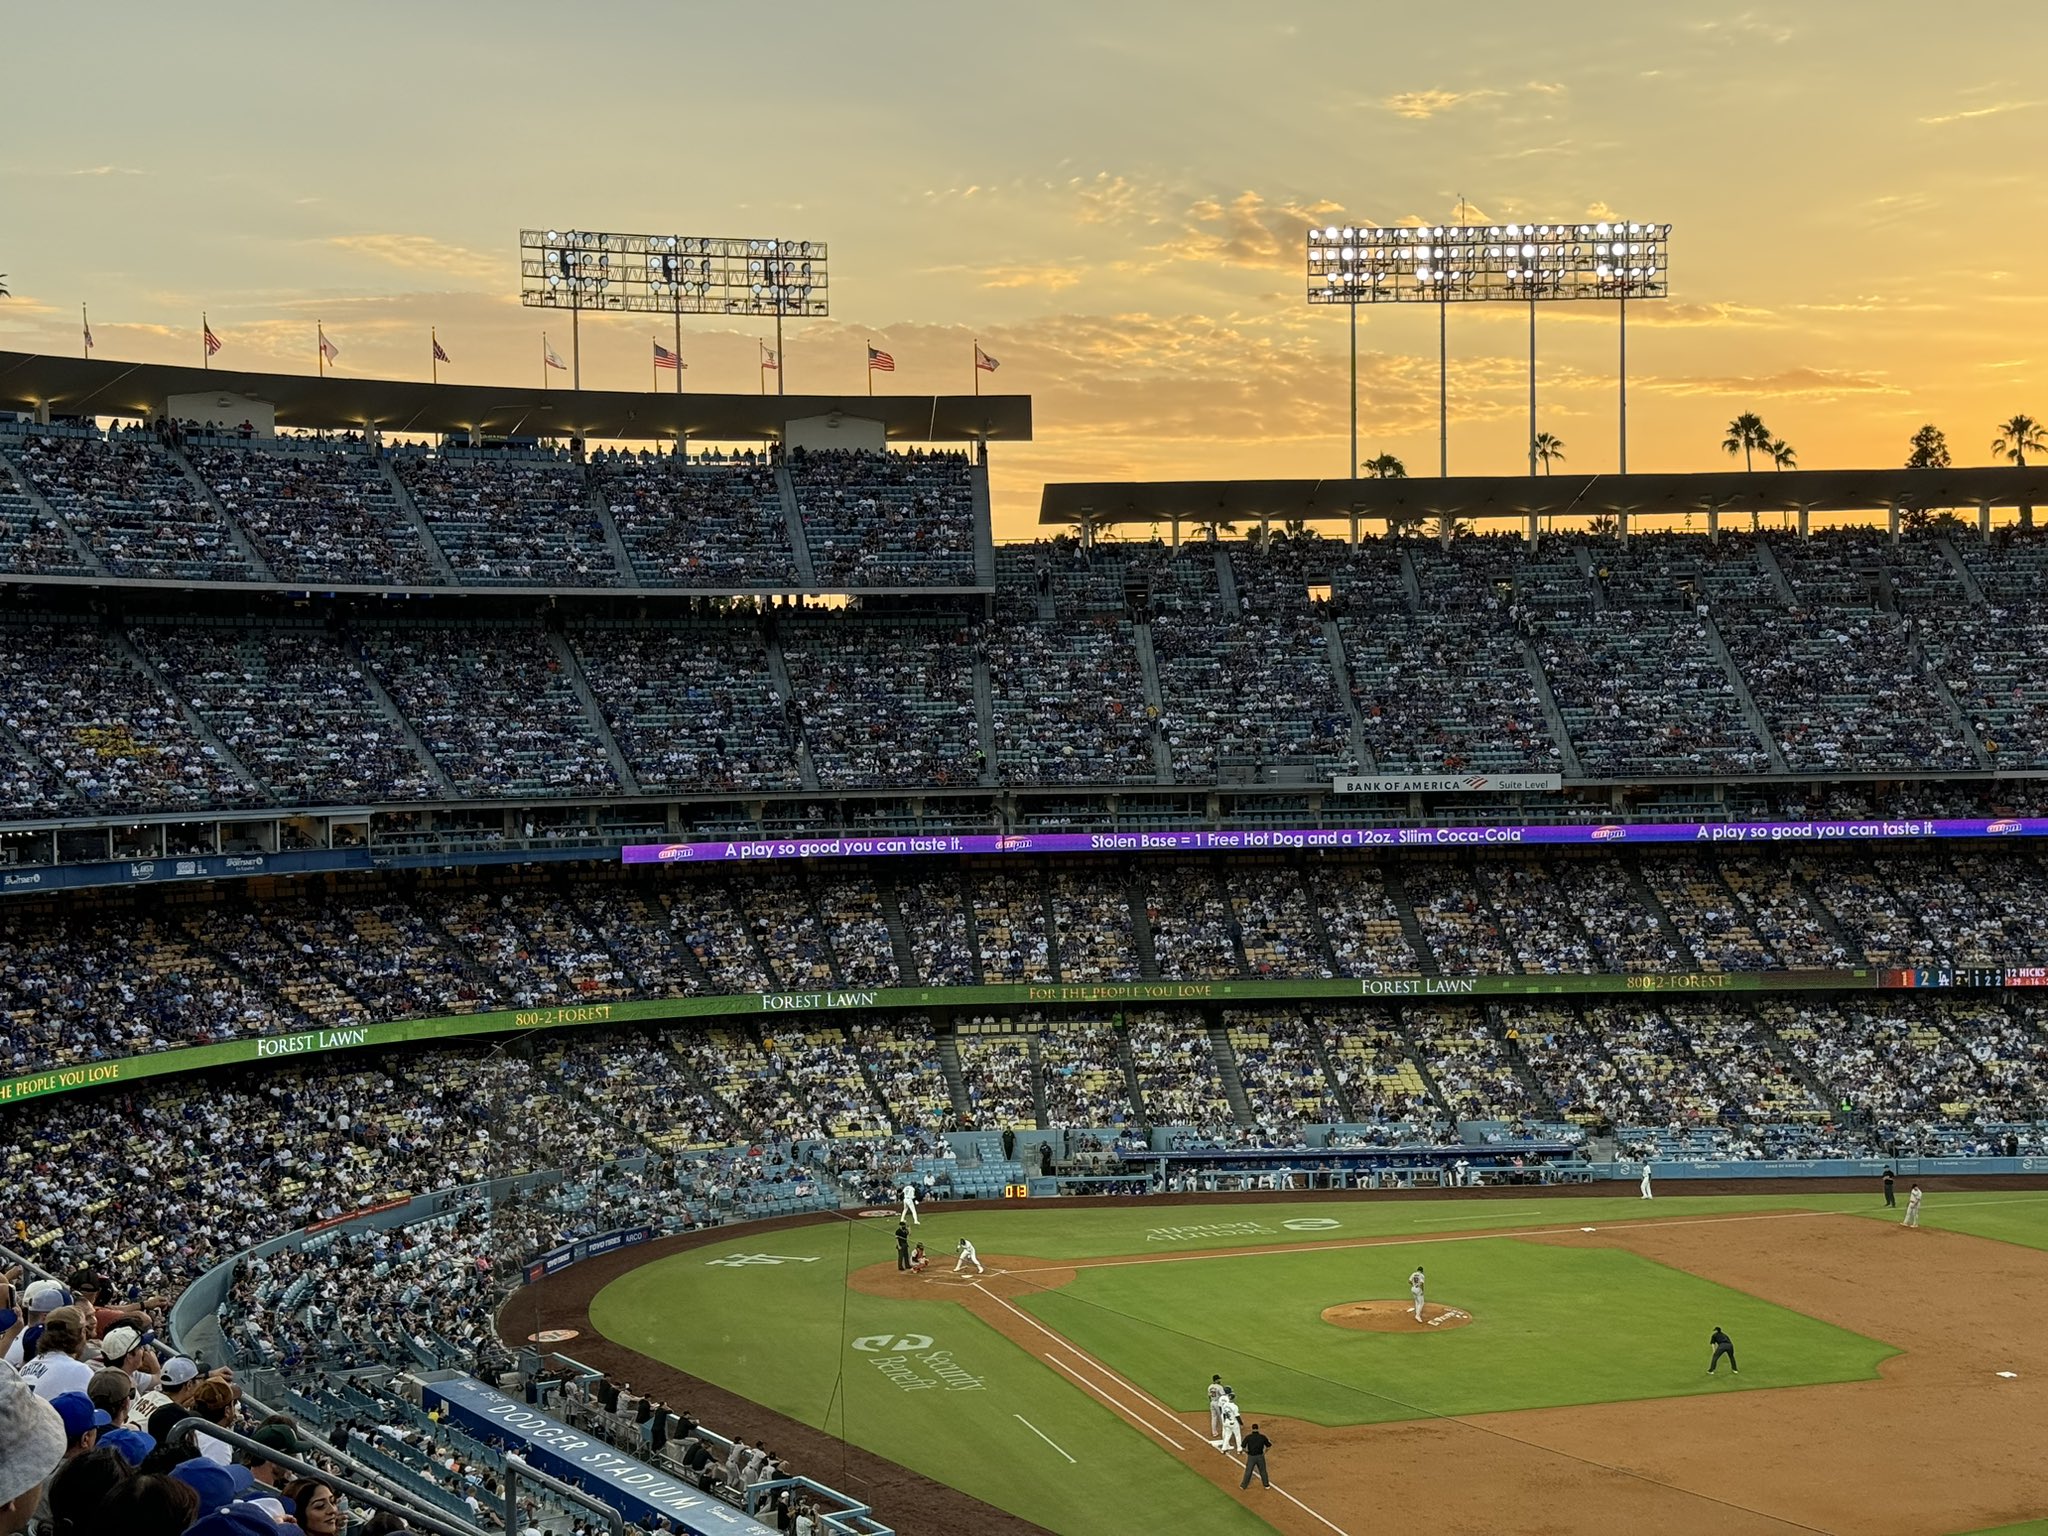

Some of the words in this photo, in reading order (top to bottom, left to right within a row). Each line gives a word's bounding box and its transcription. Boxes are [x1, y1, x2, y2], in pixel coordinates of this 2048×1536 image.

[1347, 782, 1380, 791] BANK
[1384, 782, 1400, 791] OF
[1403, 781, 1460, 790] AMERICA
[1499, 781, 1522, 790] Suite
[1525, 780, 1548, 789] Level
[1091, 834, 1137, 848] Stolen
[1141, 834, 1177, 848] Base
[1195, 834, 1201, 847] 1
[1208, 833, 1239, 846] Free
[1244, 832, 1269, 846] Hot
[1273, 832, 1304, 848] Dog
[1308, 831, 1337, 845] and
[1341, 833, 1352, 844] a
[1357, 831, 1394, 844] 12oz.
[1697, 825, 1709, 838] A
[1713, 825, 1746, 841] play
[1750, 827, 1767, 838] so
[1772, 823, 1812, 839] good
[1816, 826, 1845, 839] you
[1849, 825, 1879, 836] can
[1883, 822, 1919, 835] taste
[1923, 821, 1936, 835] it.
[725, 843, 737, 857] A
[741, 843, 774, 859] play
[778, 844, 796, 855] so
[800, 840, 839, 857] good
[844, 841, 872, 856] you
[876, 841, 906, 852] can
[910, 838, 947, 851] taste
[951, 837, 963, 850] it.
[1901, 971, 1908, 986] 1
[1921, 970, 1929, 986] 2
[1975, 976, 1979, 986] 1
[1985, 976, 1991, 986] 2
[1995, 976, 2001, 986] 2
[2007, 968, 2017, 977] 12
[2019, 968, 2046, 977] HICKS
[1029, 987, 1055, 999] FOR
[1061, 987, 1087, 999] THE
[1093, 986, 1139, 998] PEOPLE
[1144, 986, 1173, 997] YOU
[1178, 985, 1211, 997] LOVE
[1362, 979, 1420, 994] FOREST
[1426, 978, 1473, 993] LAWN
[762, 994, 821, 1010] FOREST
[826, 992, 873, 1007] LAWN
[515, 1006, 612, 1026] 800-2-FOREST
[257, 1035, 314, 1056] FOREST
[319, 1028, 364, 1048] LAWN
[16, 1076, 56, 1096] PEOPLE
[59, 1071, 85, 1087] YOU
[89, 1065, 119, 1082] LOVE
[625, 1233, 642, 1242] ARCO
[868, 1355, 937, 1392] Benefit
[915, 1350, 986, 1391] Security
[487, 1404, 589, 1451] DODGER
[581, 1452, 705, 1510] STADIUM
